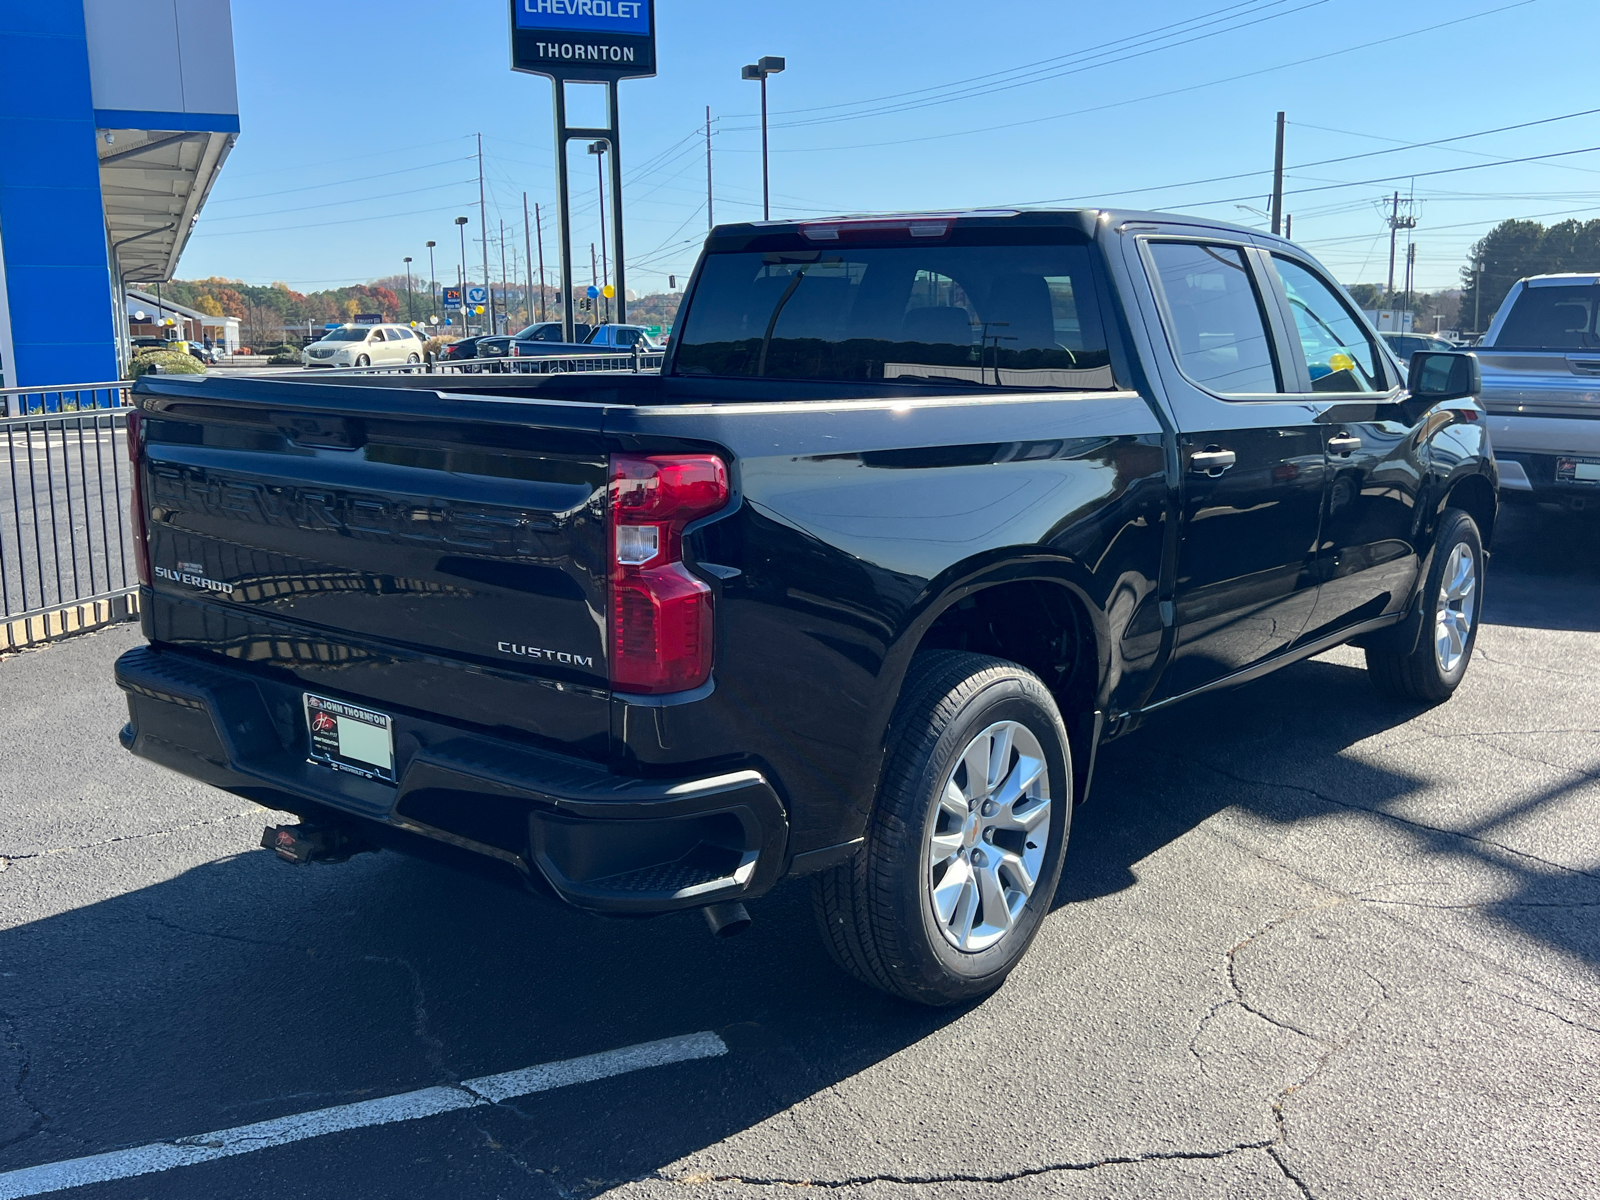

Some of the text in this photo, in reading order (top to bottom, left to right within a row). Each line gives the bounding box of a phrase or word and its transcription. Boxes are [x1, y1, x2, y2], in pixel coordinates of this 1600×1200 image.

[524, 0, 641, 18] CHEVROLET
[536, 42, 634, 62] THORNTON
[155, 566, 233, 594] SILVERADO
[498, 641, 593, 668] CUSTOM
[323, 700, 343, 714] JOHN
